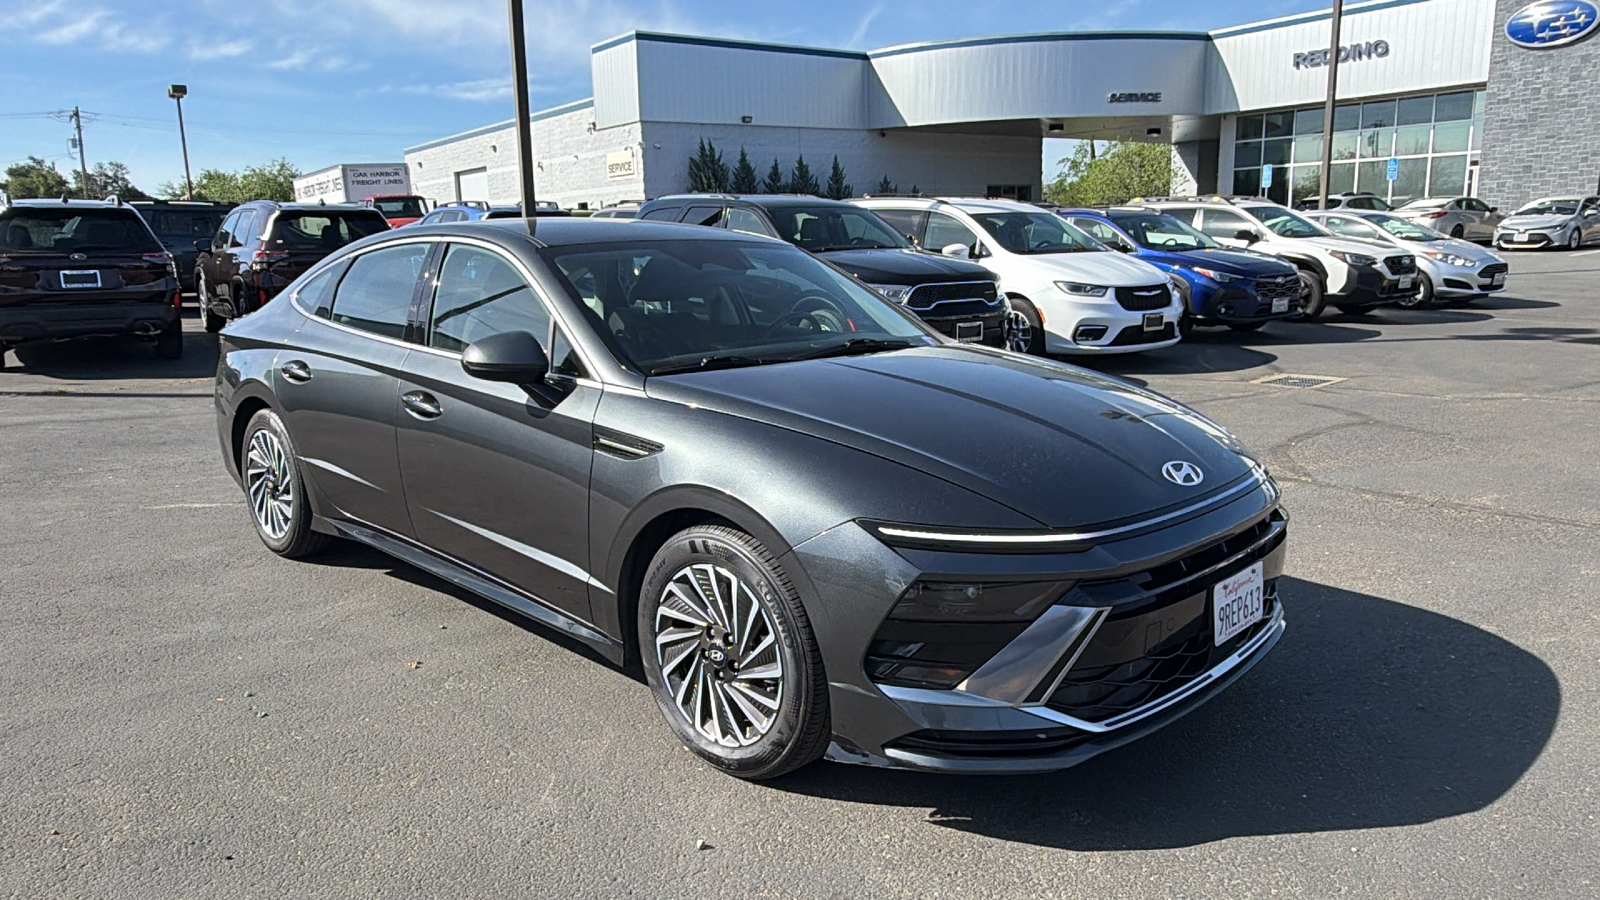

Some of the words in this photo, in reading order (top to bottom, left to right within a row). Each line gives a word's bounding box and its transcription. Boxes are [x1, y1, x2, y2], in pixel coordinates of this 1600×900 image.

[1293, 40, 1390, 70] REDDING
[1107, 92, 1162, 103] SERVICE
[608, 161, 632, 174] SERVICE
[1225, 576, 1255, 599] California
[1218, 586, 1261, 636] 9REP613
